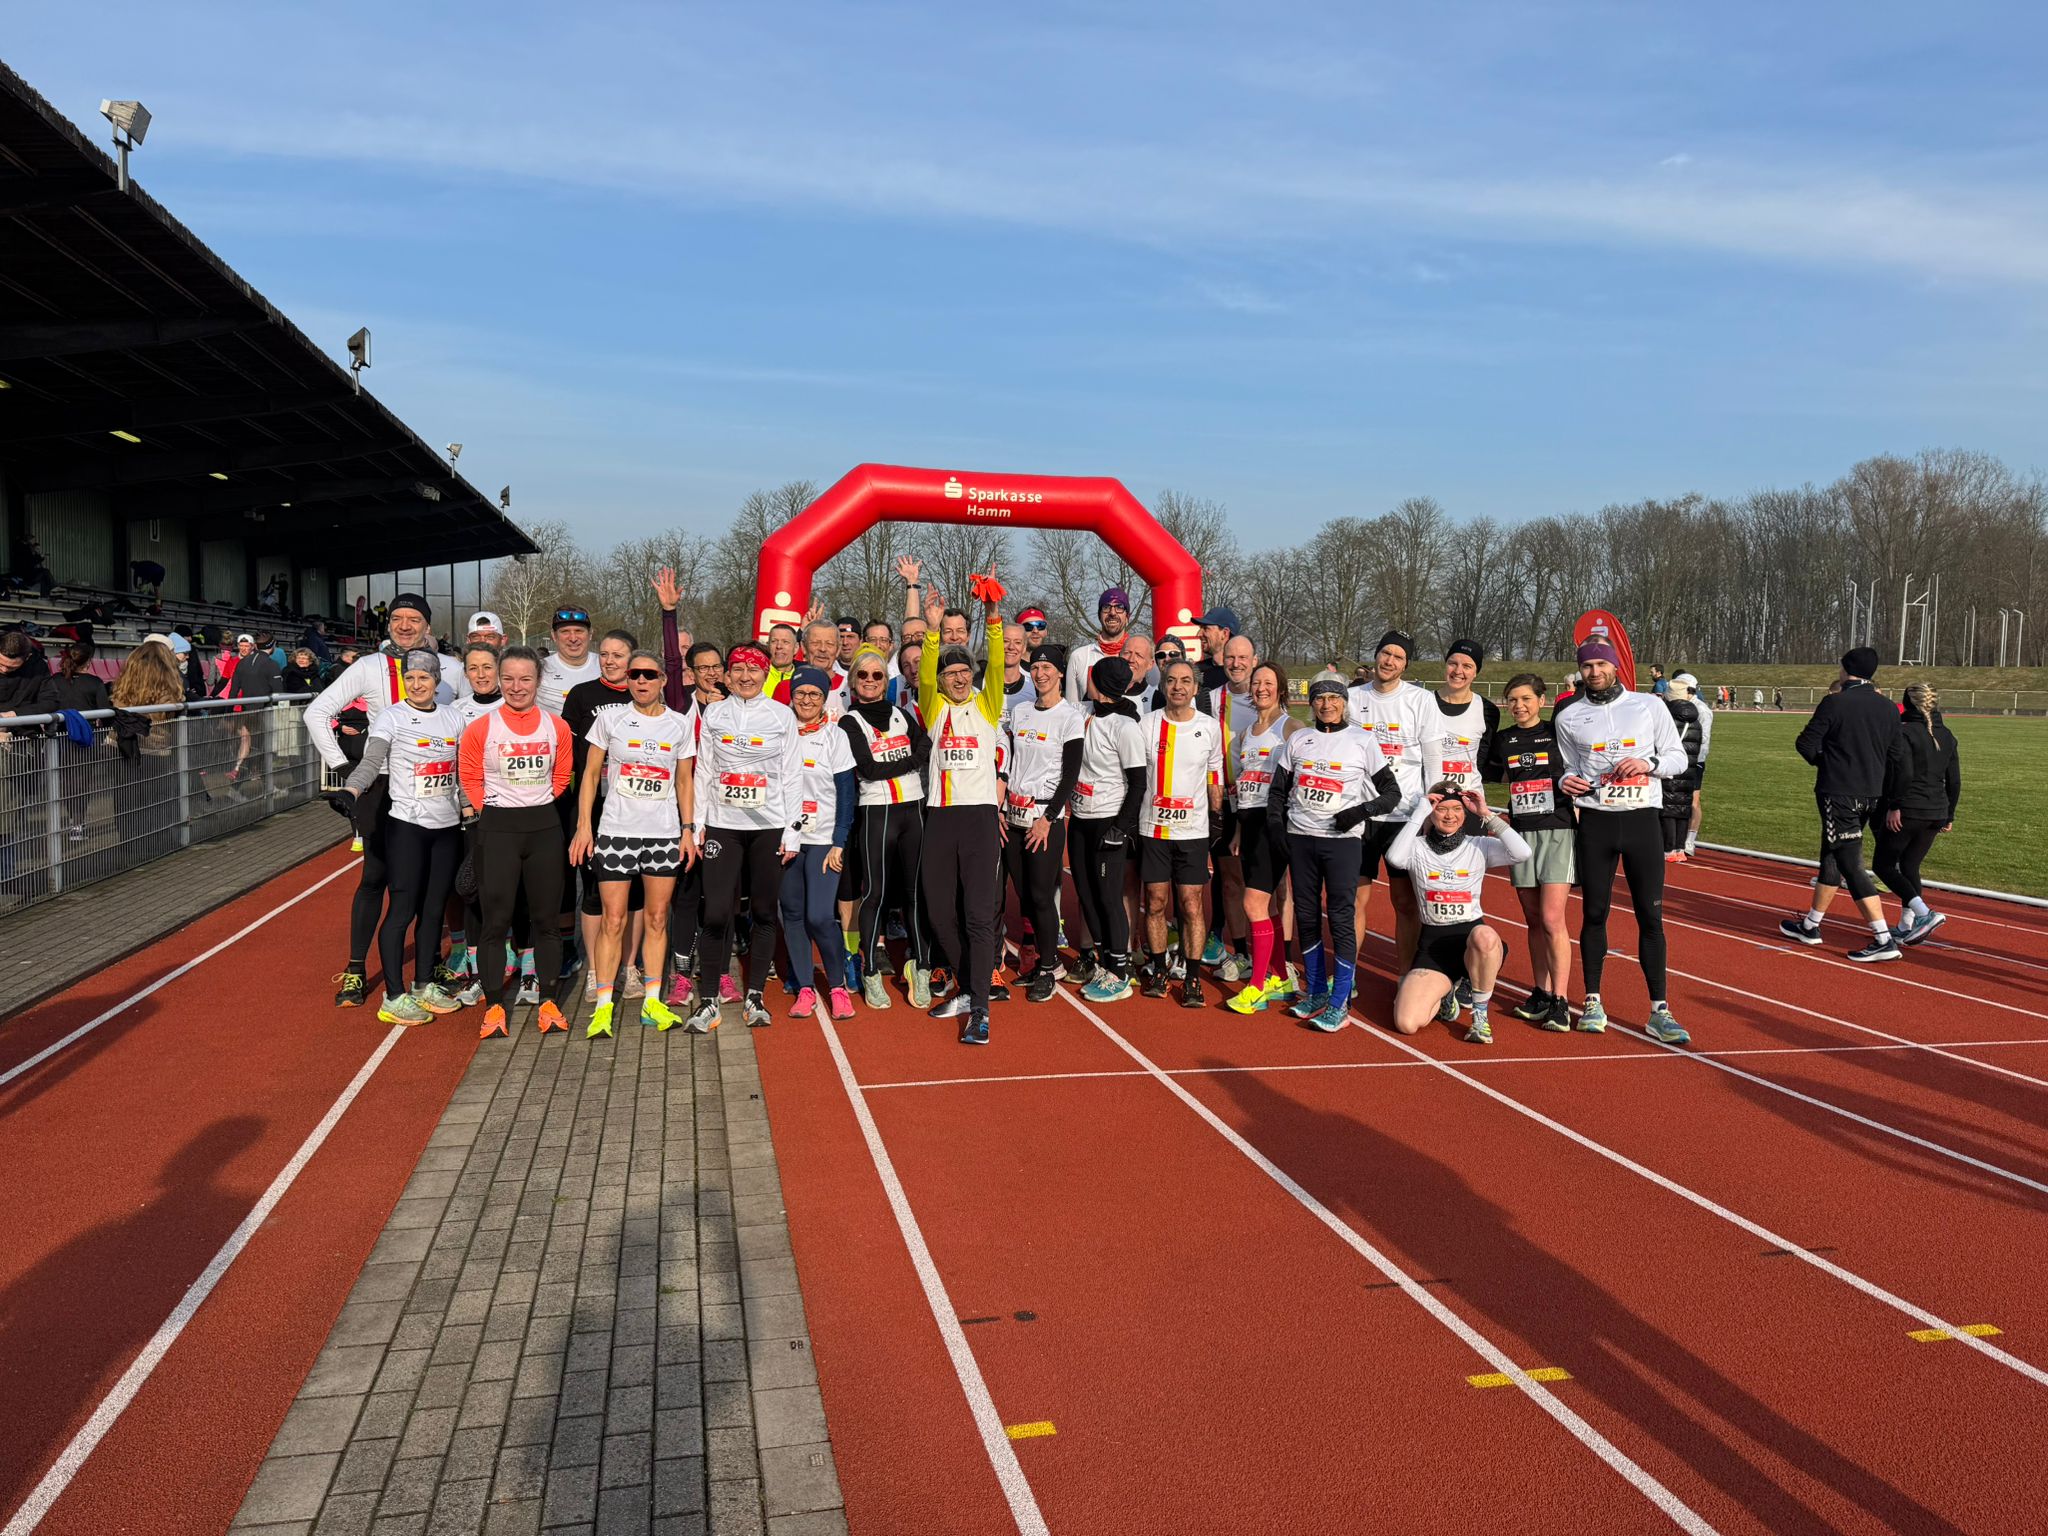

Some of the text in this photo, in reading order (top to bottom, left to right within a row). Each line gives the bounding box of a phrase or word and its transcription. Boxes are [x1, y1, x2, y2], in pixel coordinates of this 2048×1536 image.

[968, 487, 1043, 503] Sparkasse
[967, 504, 1012, 518] Hamm
[880, 747, 908, 762] 1685
[943, 749, 974, 761] 1686
[507, 756, 543, 770] 2616
[424, 773, 453, 788] 2726
[627, 777, 662, 793] 1786
[1240, 781, 1261, 793] 2361
[725, 786, 757, 799] 2331
[1303, 787, 1334, 803] 1287
[1516, 792, 1547, 806] 2173
[1608, 786, 1642, 798] 2217
[1158, 808, 1187, 820] 2240
[1433, 903, 1465, 915] 1533
